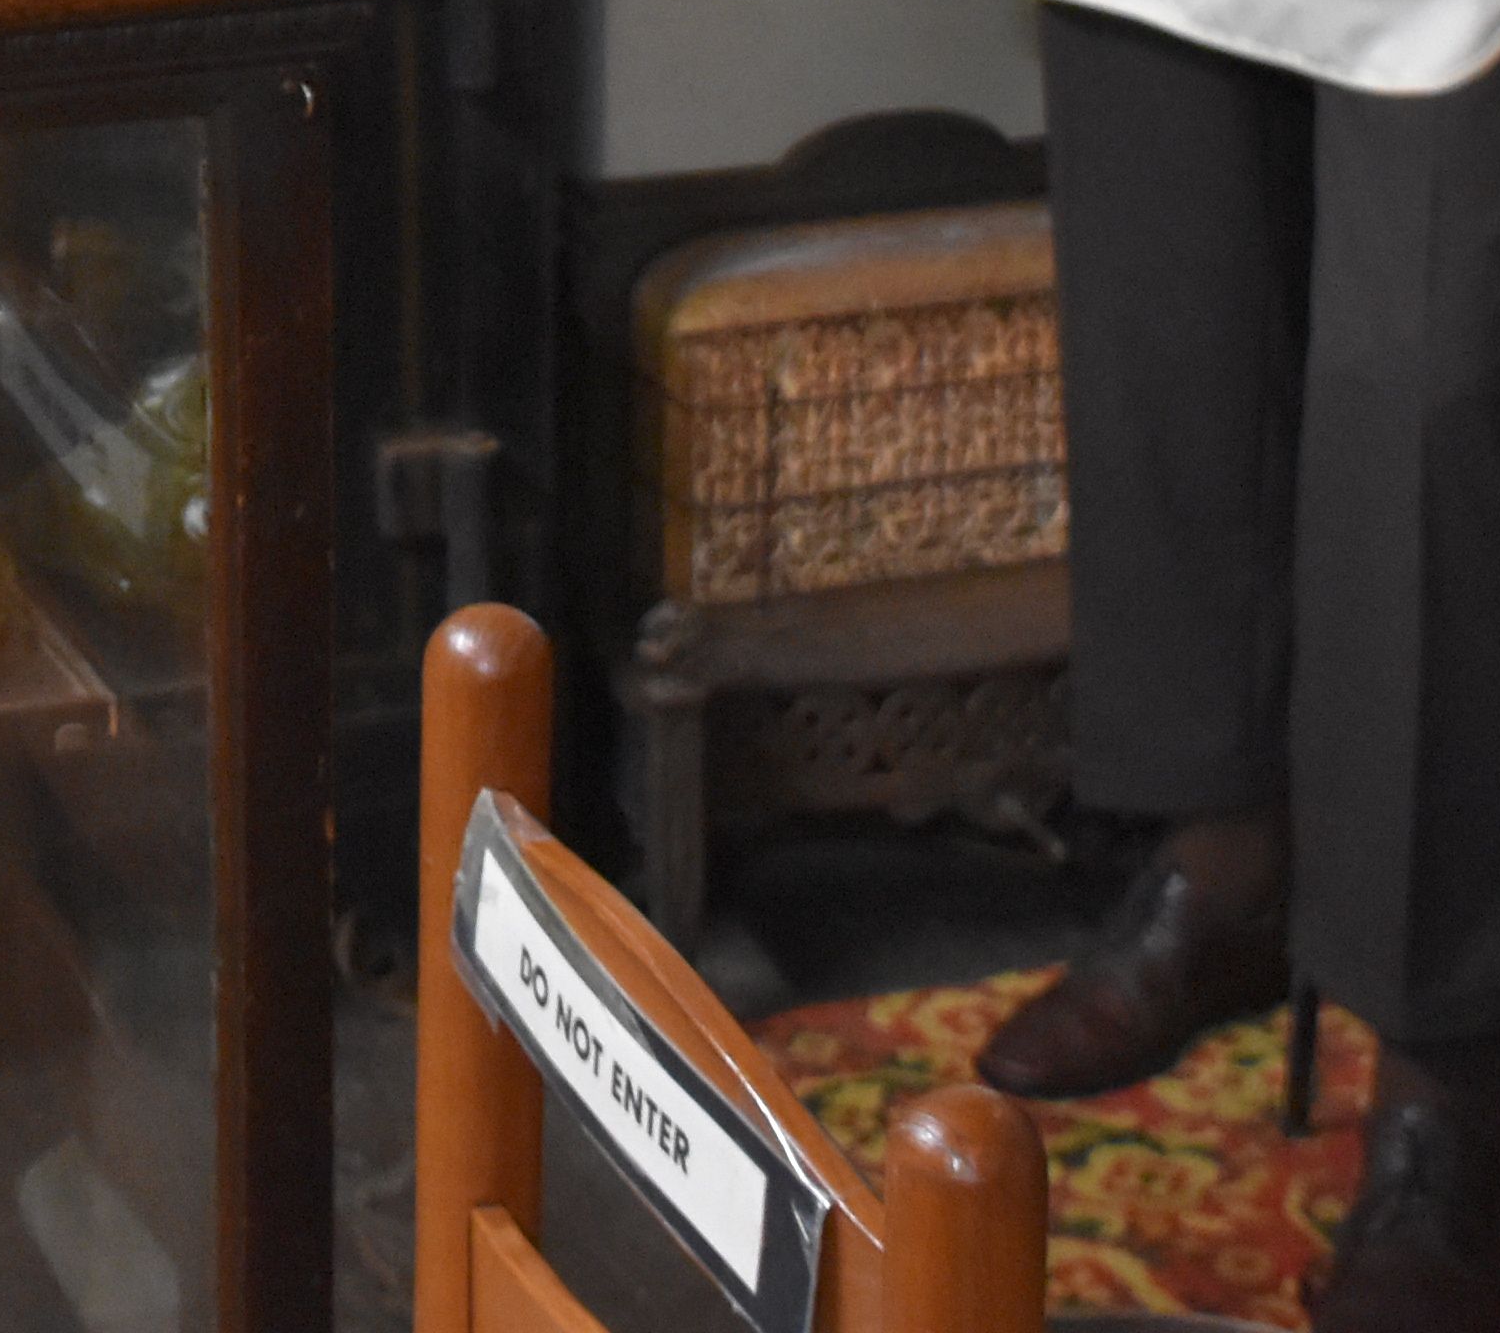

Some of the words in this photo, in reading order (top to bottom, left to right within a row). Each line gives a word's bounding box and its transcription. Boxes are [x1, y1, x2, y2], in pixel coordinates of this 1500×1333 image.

[520, 943, 549, 1008] DO
[555, 992, 604, 1078] NOT
[611, 1058, 691, 1175] ENTER
